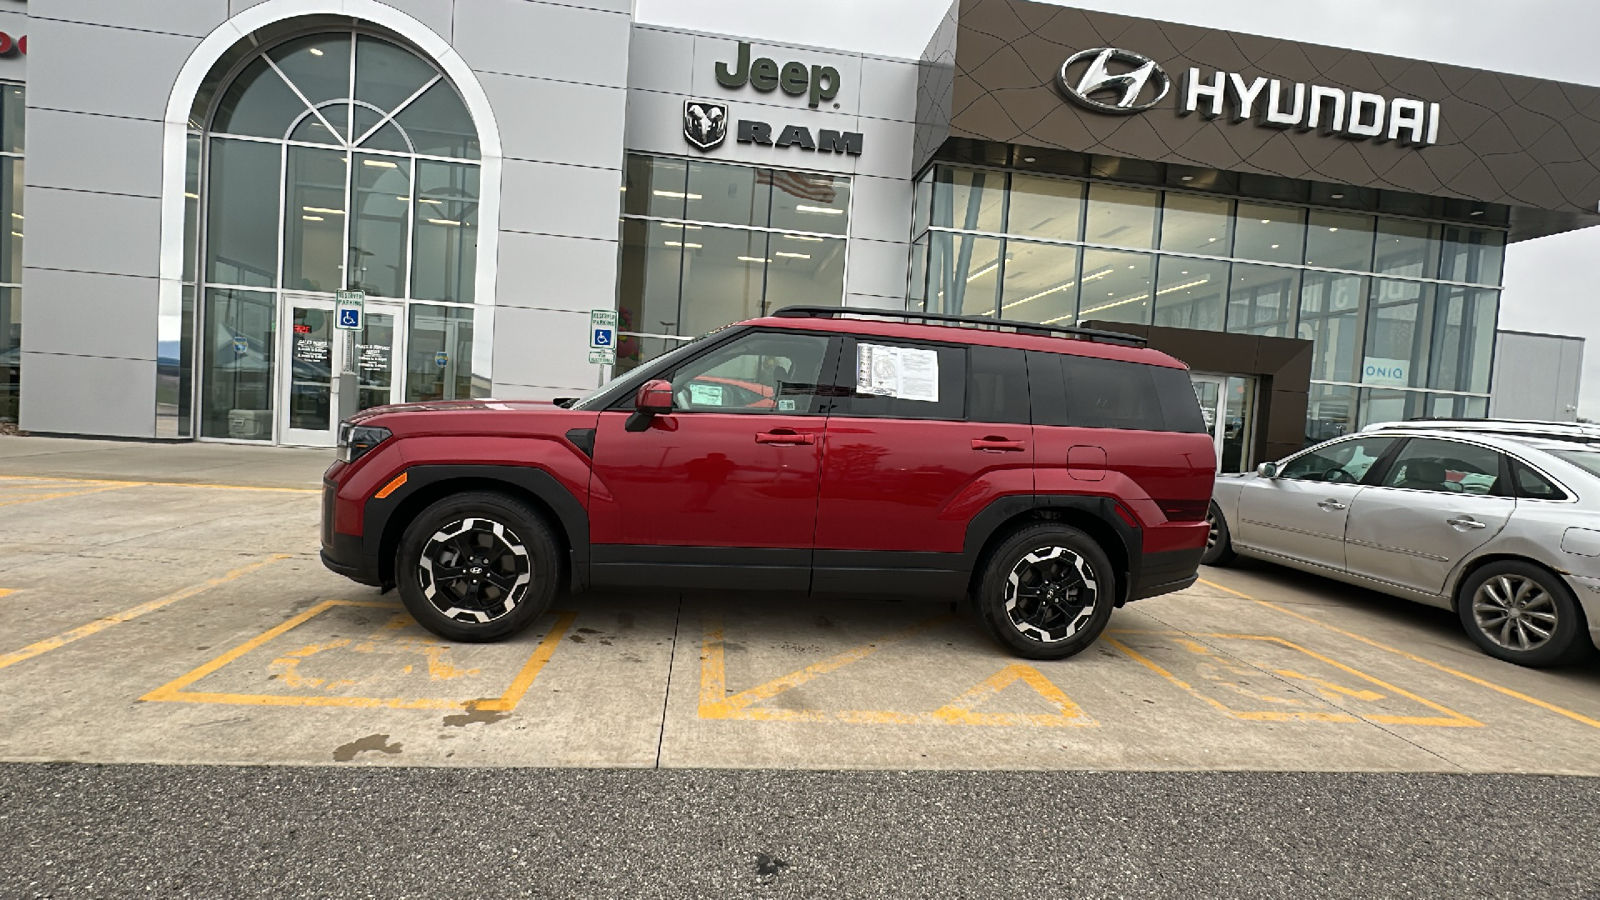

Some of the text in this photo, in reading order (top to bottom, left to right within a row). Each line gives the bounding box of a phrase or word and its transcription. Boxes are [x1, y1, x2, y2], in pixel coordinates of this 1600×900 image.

[715, 42, 840, 108] Jeep
[1181, 67, 1440, 147] HYUNDAI
[737, 120, 863, 155] RAM
